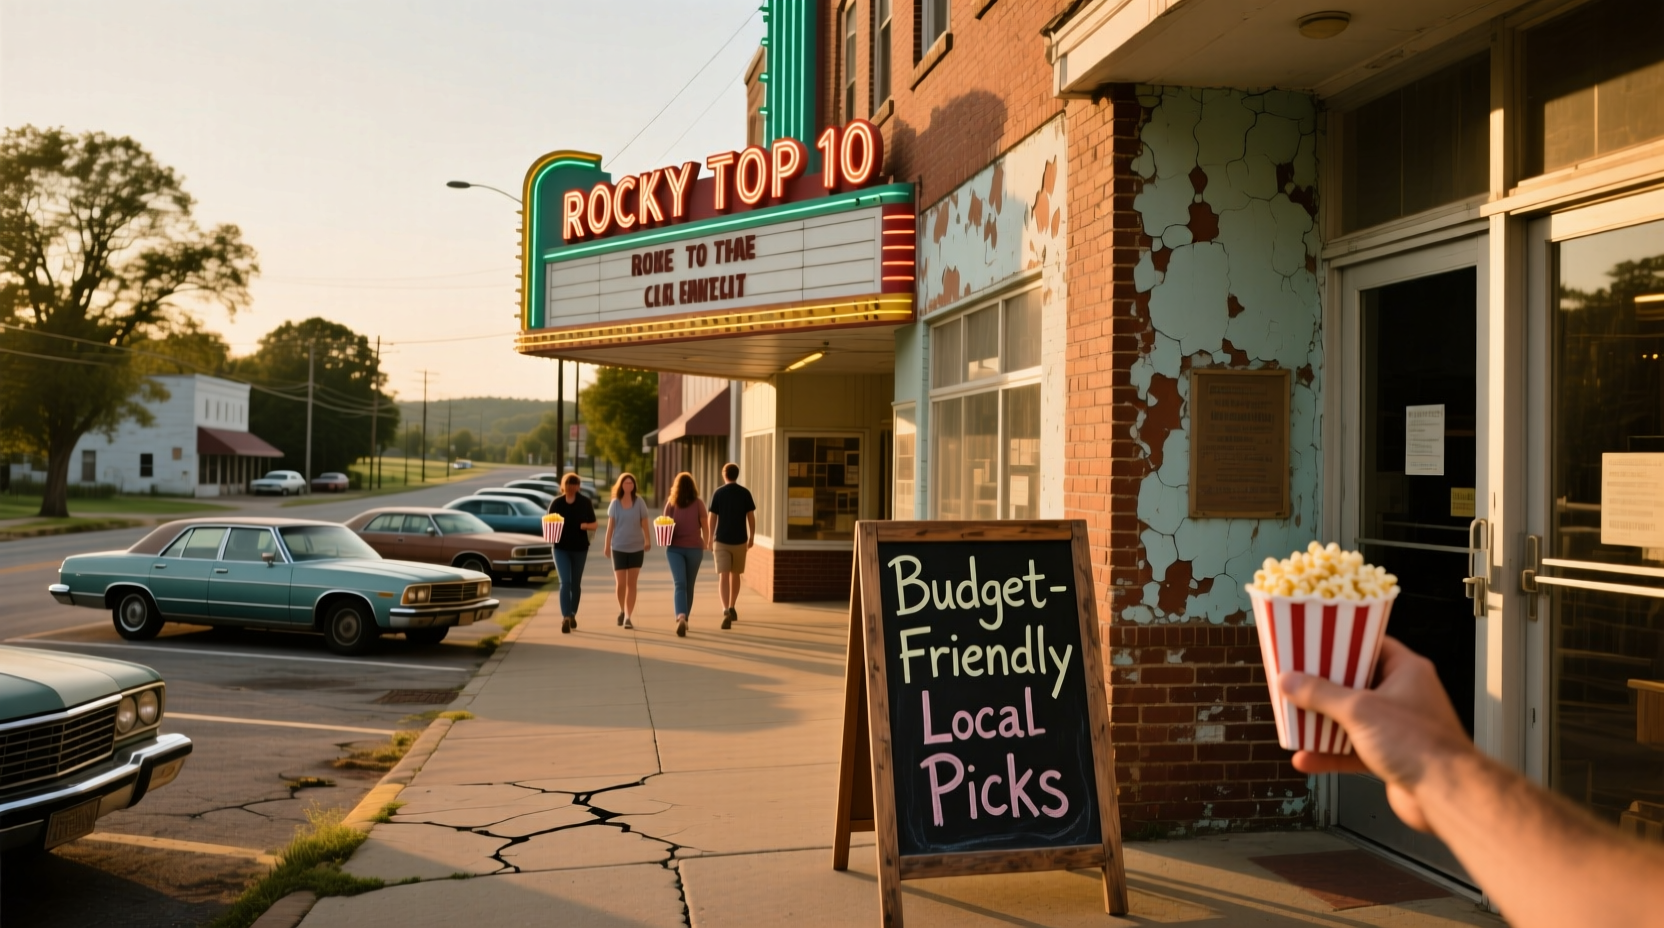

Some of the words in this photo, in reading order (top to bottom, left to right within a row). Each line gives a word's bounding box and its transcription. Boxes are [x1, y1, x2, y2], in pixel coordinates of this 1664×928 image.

[562, 161, 700, 241] ROCKY
[707, 137, 806, 211] TOP
[816, 118, 881, 190] 10
[685, 243, 708, 269] TO
[887, 554, 1067, 631] Budget-
[899, 624, 1073, 700] Friendly
[919, 752, 1070, 827] Picks
